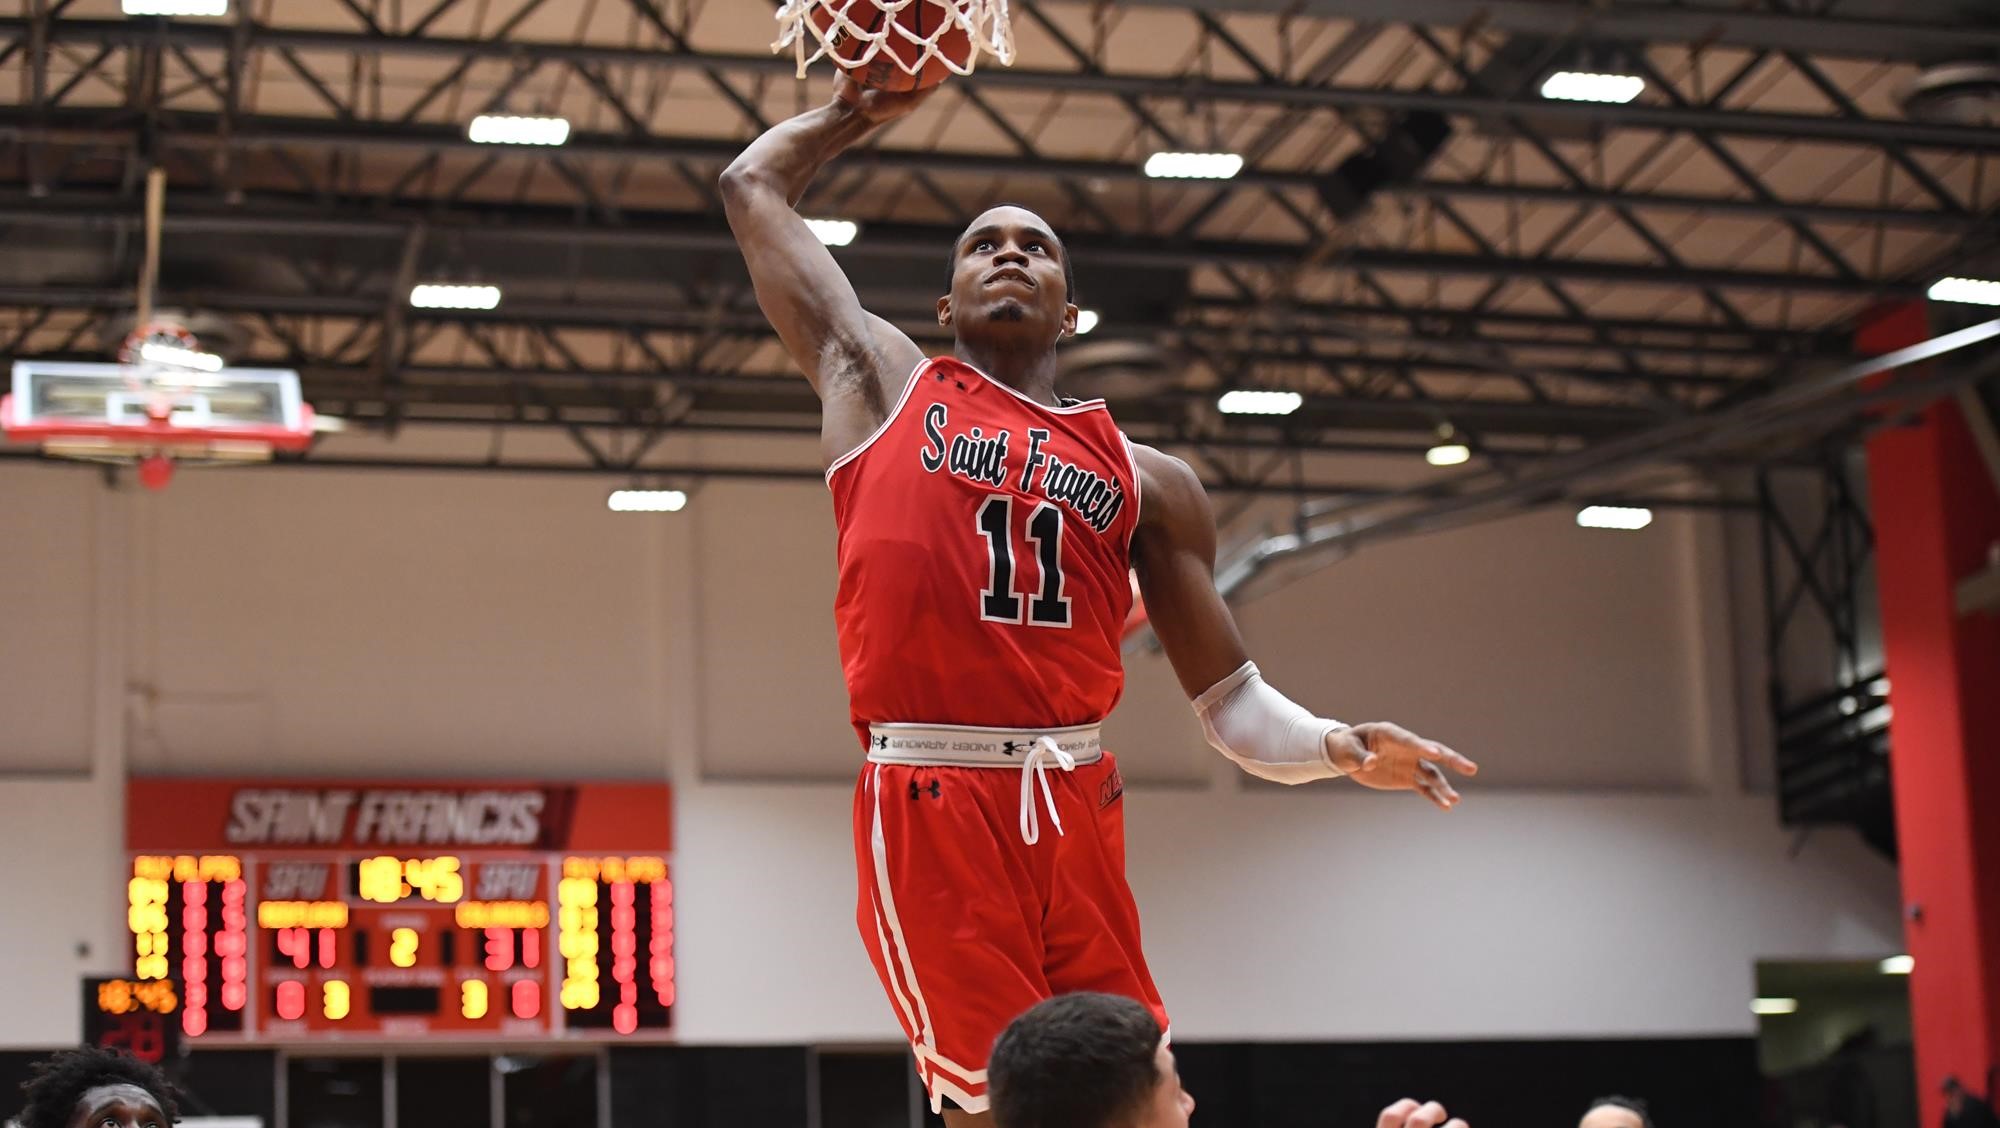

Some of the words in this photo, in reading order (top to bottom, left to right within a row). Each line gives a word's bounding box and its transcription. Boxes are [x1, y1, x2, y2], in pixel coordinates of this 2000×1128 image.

[921, 403, 1010, 488] Saint
[1019, 428, 1125, 533] Francis
[976, 494, 1072, 629] 11
[890, 737, 948, 750] ARMOUR
[952, 741, 997, 752] UNDER
[226, 788, 351, 843] SAINT
[354, 790, 545, 844] FRANCIS
[277, 927, 336, 969] 41
[390, 927, 419, 967] 2
[485, 927, 540, 971] 31
